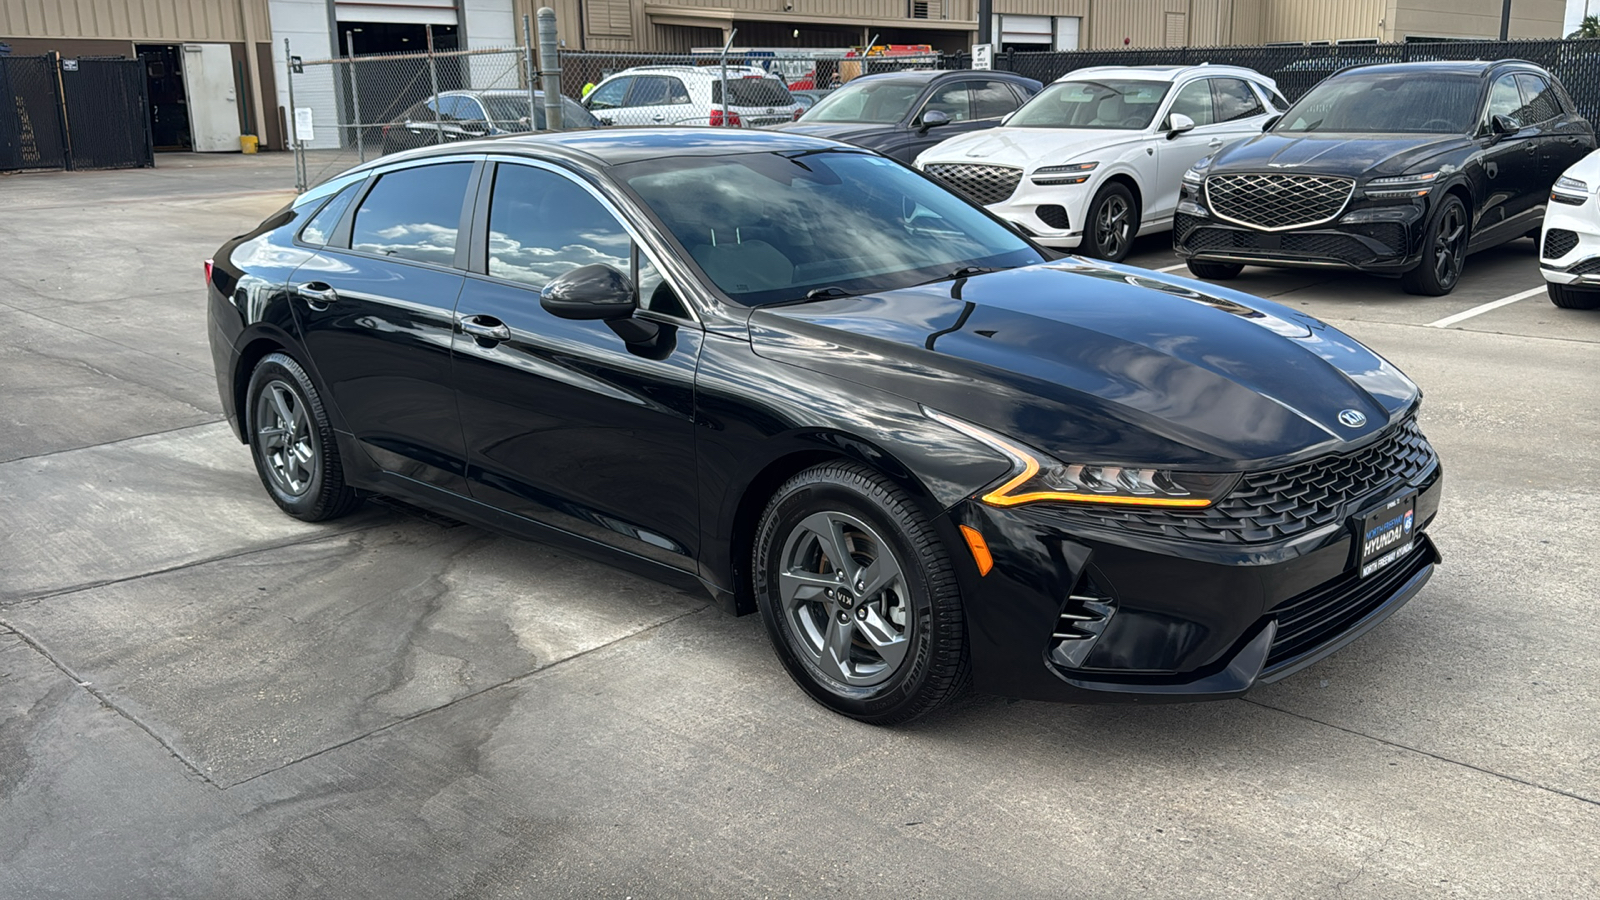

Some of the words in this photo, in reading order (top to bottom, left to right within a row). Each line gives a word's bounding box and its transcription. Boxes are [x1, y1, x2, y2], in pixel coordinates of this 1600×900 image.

[760, 514, 779, 568] MICHELIN
[1364, 525, 1402, 557] HYUNDAI
[837, 591, 852, 606] KIA
[902, 636, 928, 694] MICHELIN
